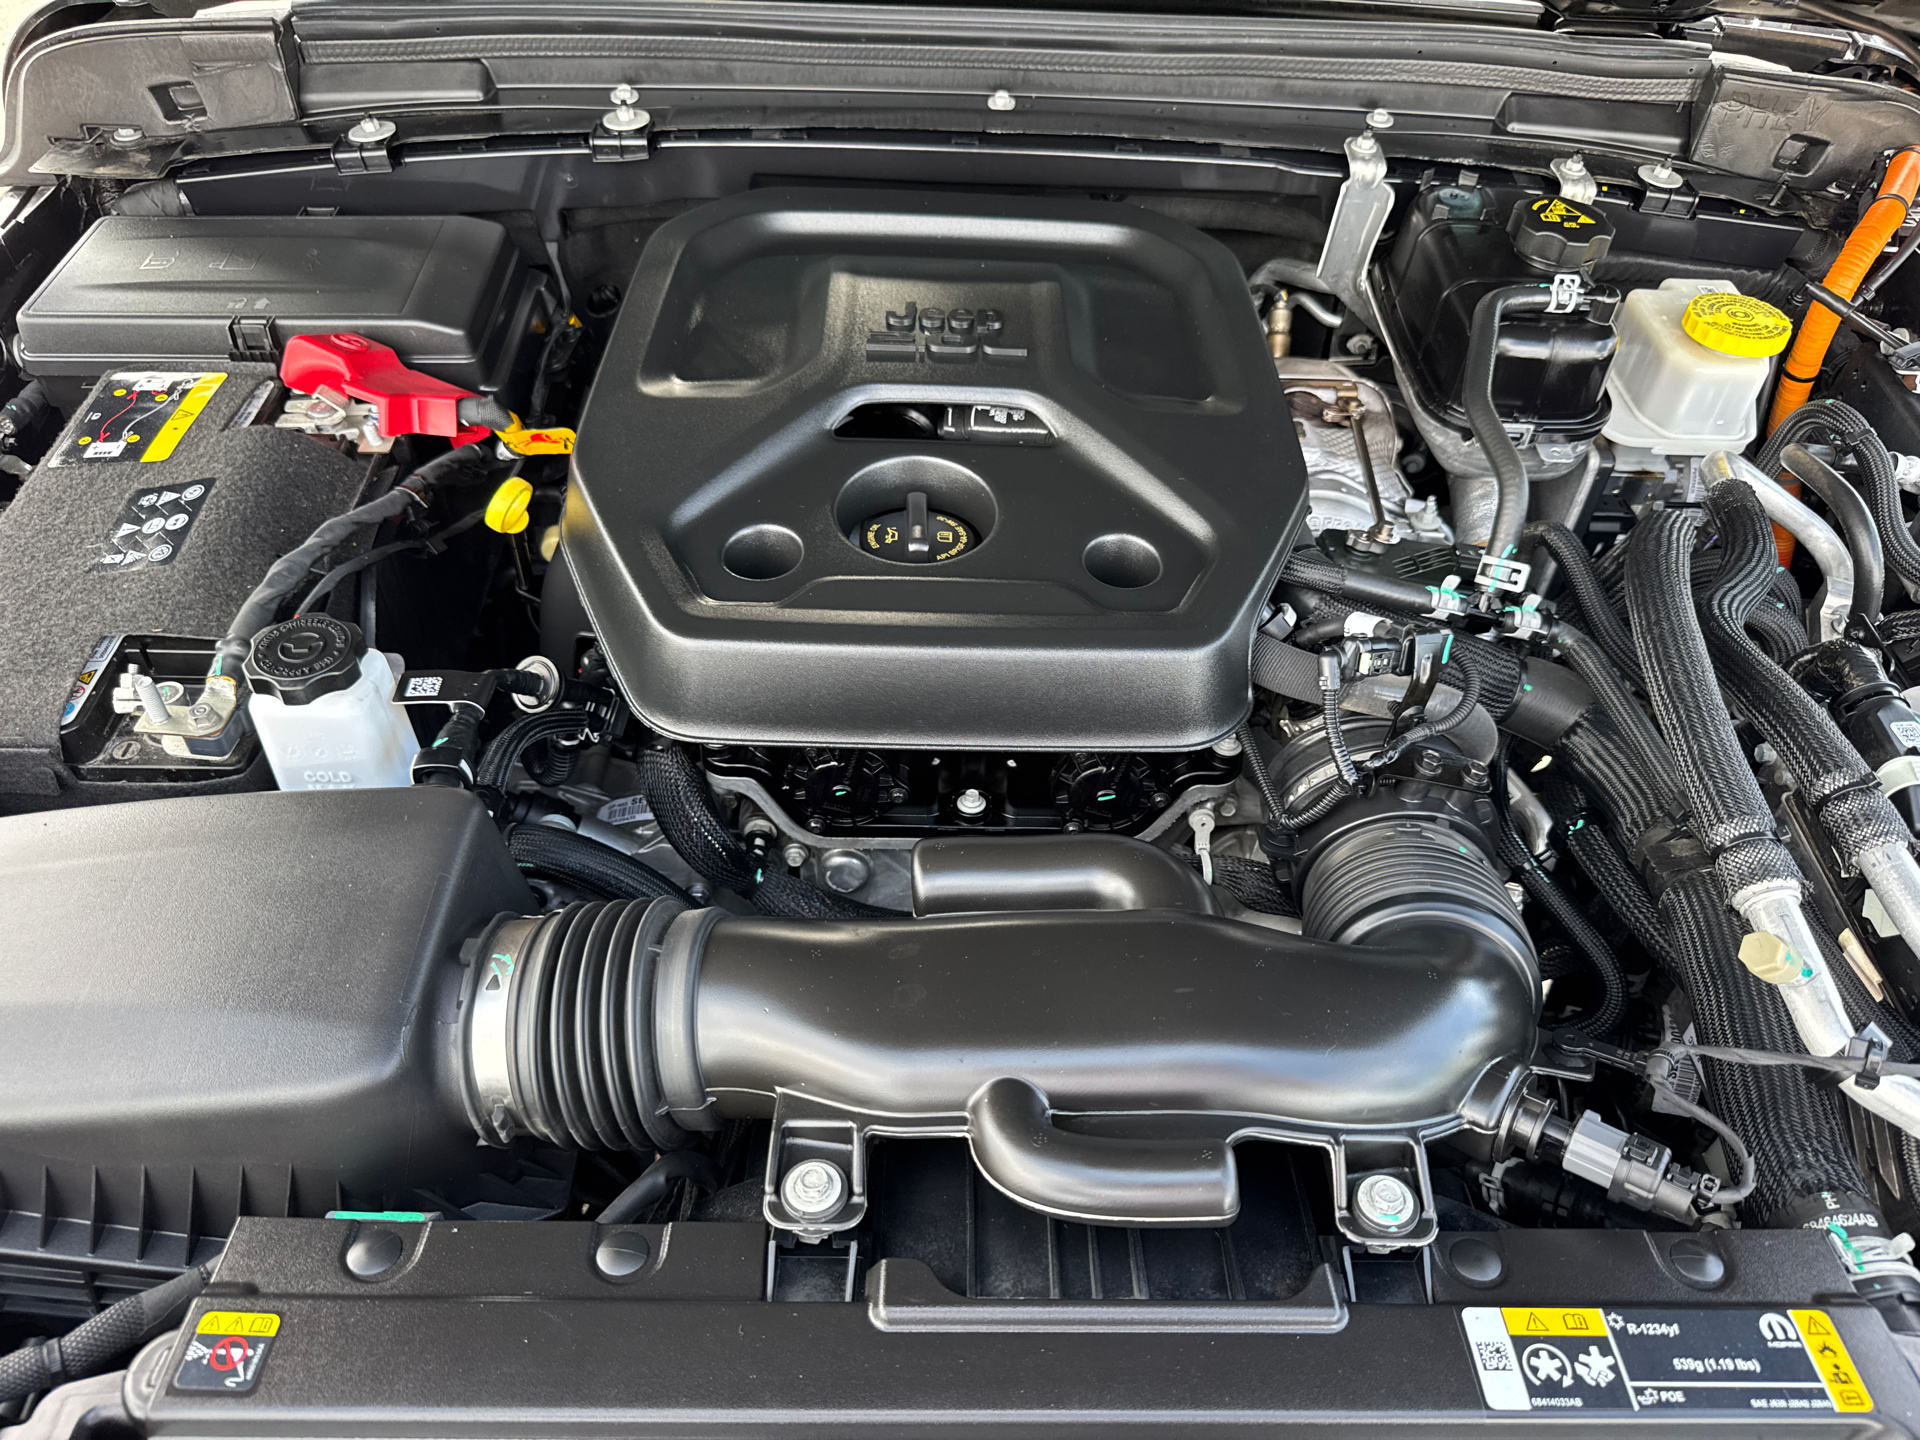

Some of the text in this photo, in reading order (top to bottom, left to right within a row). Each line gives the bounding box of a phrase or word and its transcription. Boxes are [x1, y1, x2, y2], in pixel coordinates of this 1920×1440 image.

[886, 301, 1003, 333] Jeep
[866, 531, 880, 549] ENGINE
[279, 618, 330, 633] STEERING
[260, 659, 311, 677] APPROVED
[303, 771, 353, 783] COLD
[1626, 1322, 1681, 1338] R-1234yf
[1672, 1357, 1761, 1373] 539g (1.19 lbs)
[1659, 1390, 1686, 1403] POE
